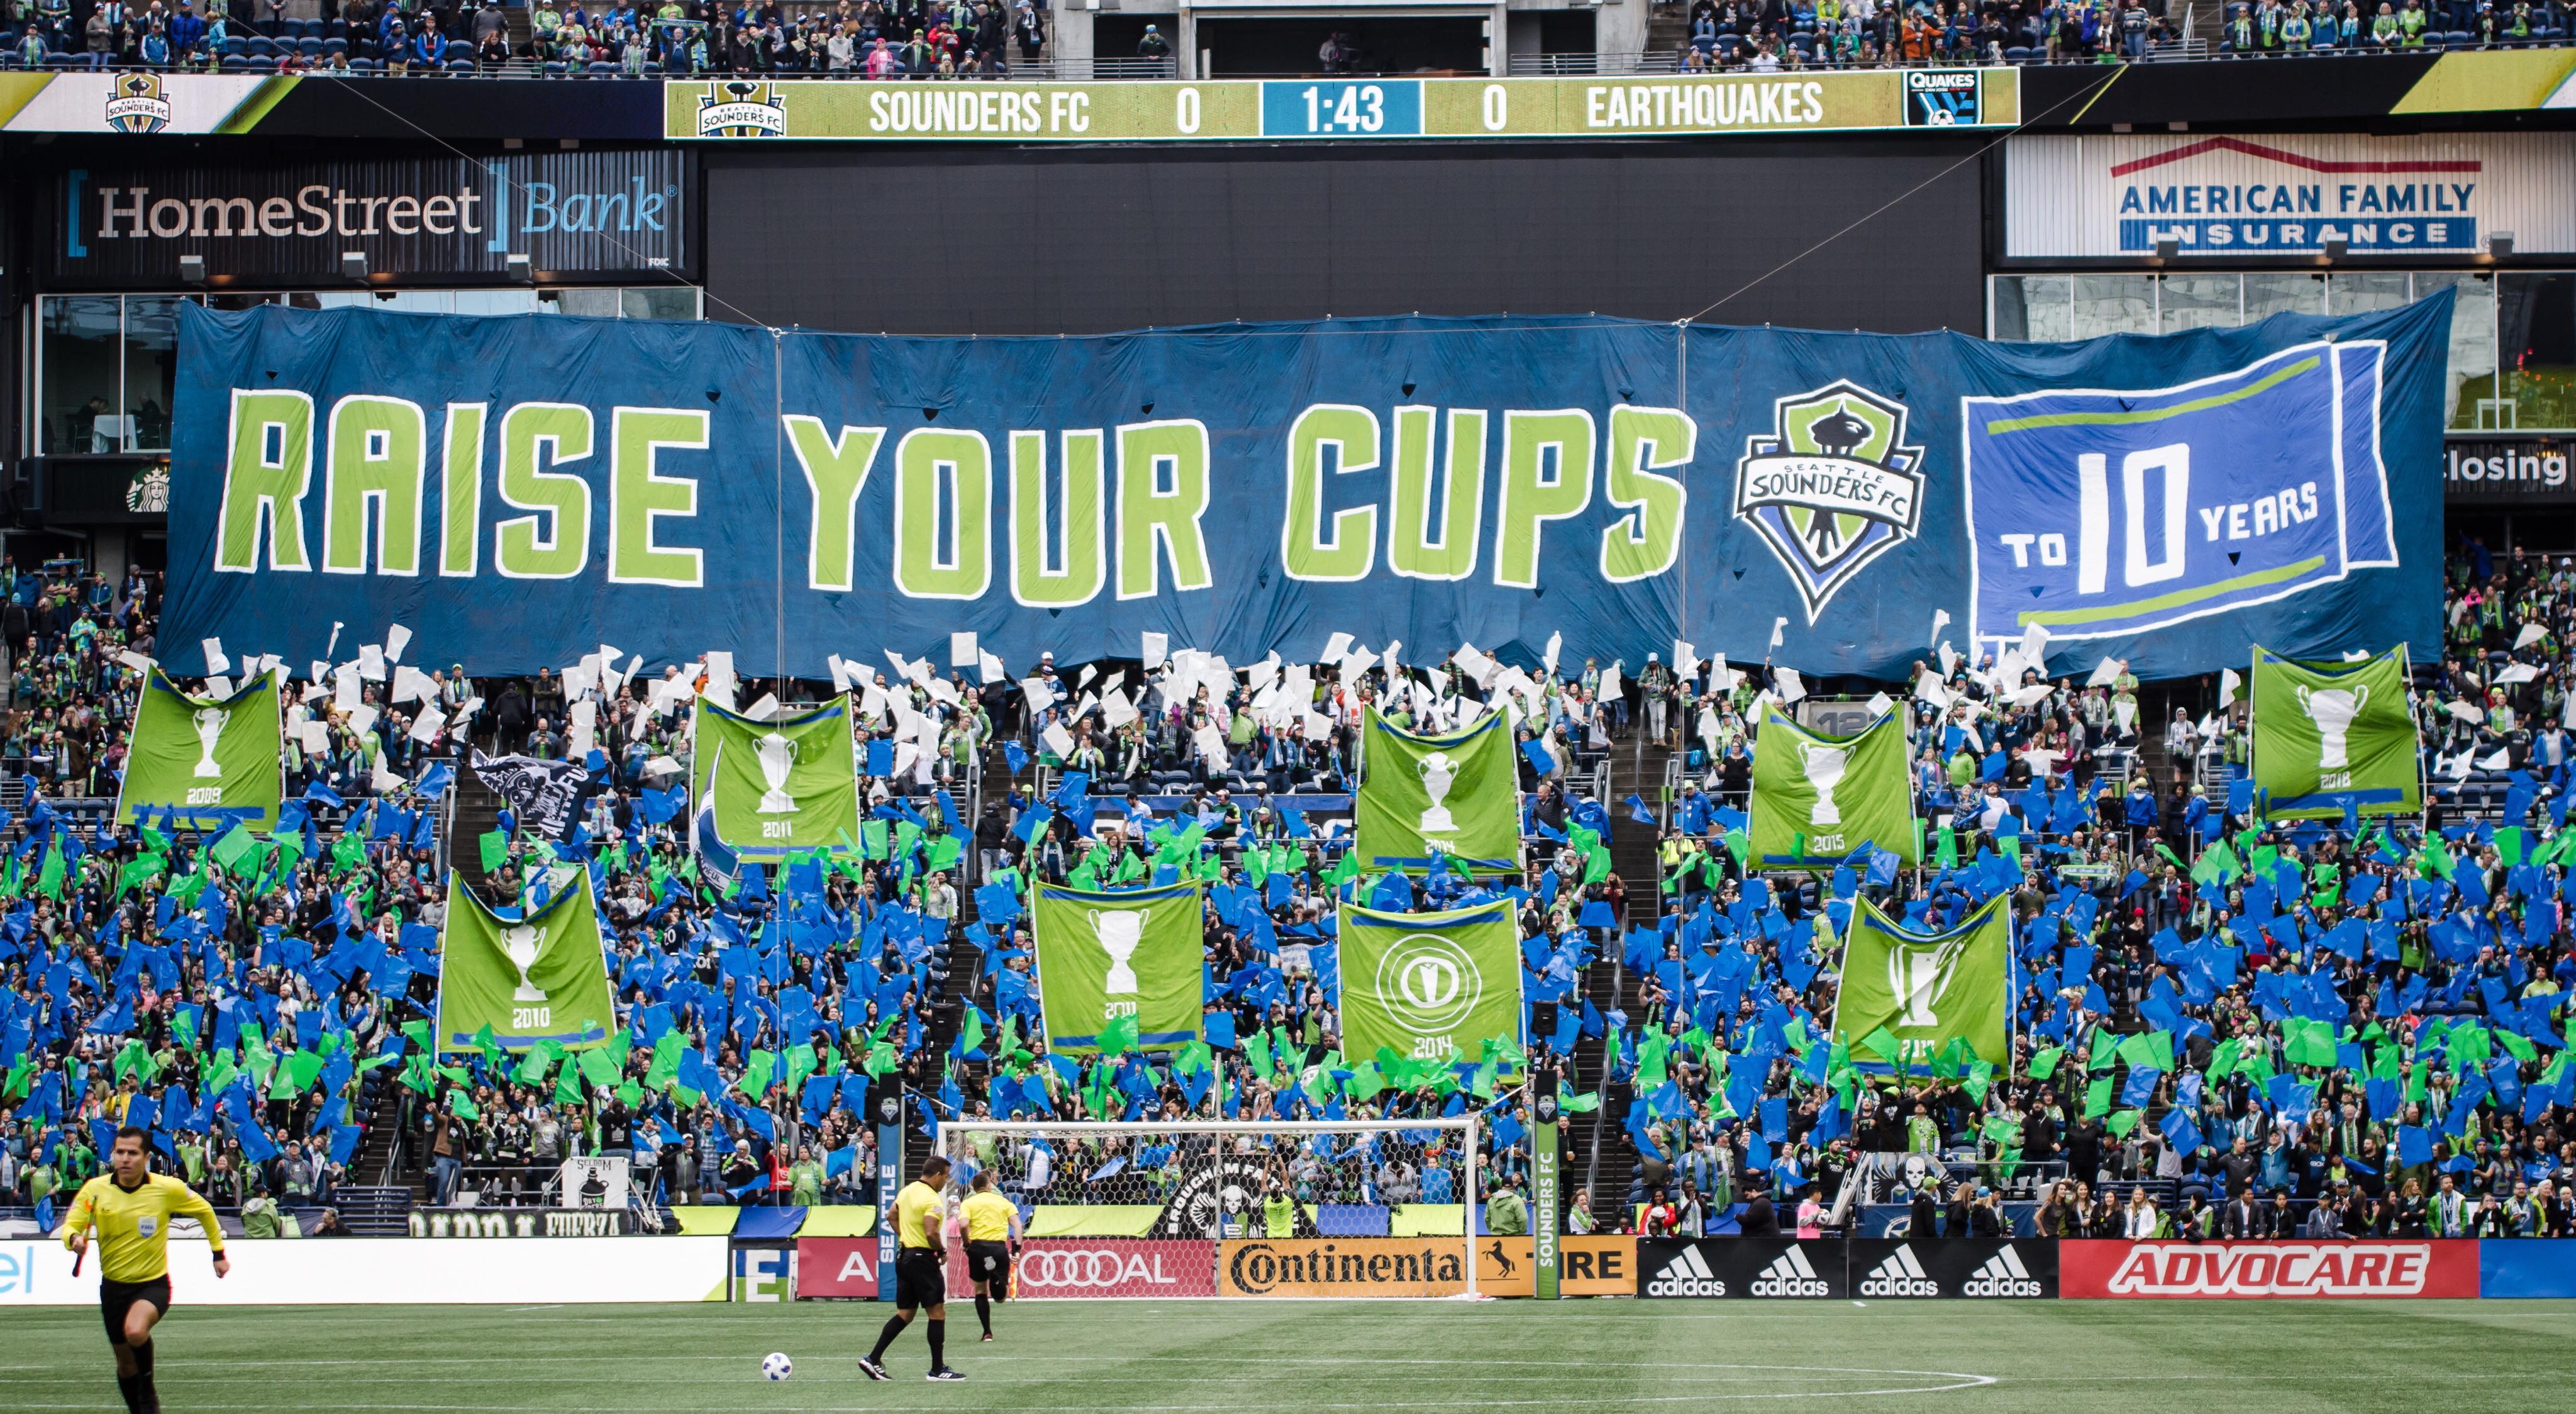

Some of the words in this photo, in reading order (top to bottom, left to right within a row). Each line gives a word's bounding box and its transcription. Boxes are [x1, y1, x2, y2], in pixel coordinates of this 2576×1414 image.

[1910, 72, 1975, 88] QUAKES
[109, 104, 155, 116] SOUNDERS
[157, 108, 168, 118] FC
[870, 91, 1041, 132] SOUNDERS
[1050, 91, 1091, 132] FC
[1177, 87, 1201, 134] 0
[1302, 85, 1384, 132] 1:43
[1483, 84, 1507, 131] 0
[1587, 82, 1823, 127] EARTHQUAKES
[704, 112, 764, 128] SOUNDERS
[767, 116, 780, 129] FC
[99, 184, 482, 238] HomeStreet
[521, 175, 665, 234] Bank
[2119, 184, 2321, 214] AMERICAN
[2340, 183, 2476, 213] FAMILY
[2147, 223, 2448, 245] INSURANCE
[648, 257, 670, 267] FDIC
[1784, 463, 1885, 484] SEATTLE
[2444, 449, 2567, 486] losing
[214, 387, 711, 588] RAISE
[782, 414, 1213, 609] YOUR
[1282, 404, 1697, 589] CUPS
[1750, 471, 1877, 504] SOUNDERS
[1879, 491, 1908, 516] FC
[2001, 533, 2068, 568] TO
[2077, 442, 2190, 595] 10
[2199, 482, 2319, 543] YEARS
[1818, 711, 1880, 737] 12
[2319, 771, 2351, 789] 2018
[762, 820, 792, 838] 2011
[1813, 833, 1846, 853] 2015
[663, 928, 677, 946] 20
[513, 1006, 550, 1029] 2010
[1414, 1034, 1453, 1059] 2014
[1539, 1151, 1554, 1174] FC
[881, 1164, 897, 1264] SEATTLE
[1539, 1177, 1554, 1268] SOUNDERS
[746, 1250, 780, 1302] E
[2112, 1246, 2429, 1293] ADVOCARE
[1648, 1277, 1726, 1297] adidas
[1751, 1277, 1829, 1297] adidas
[1860, 1277, 1939, 1297] adidas
[1964, 1277, 2042, 1297] adidas
